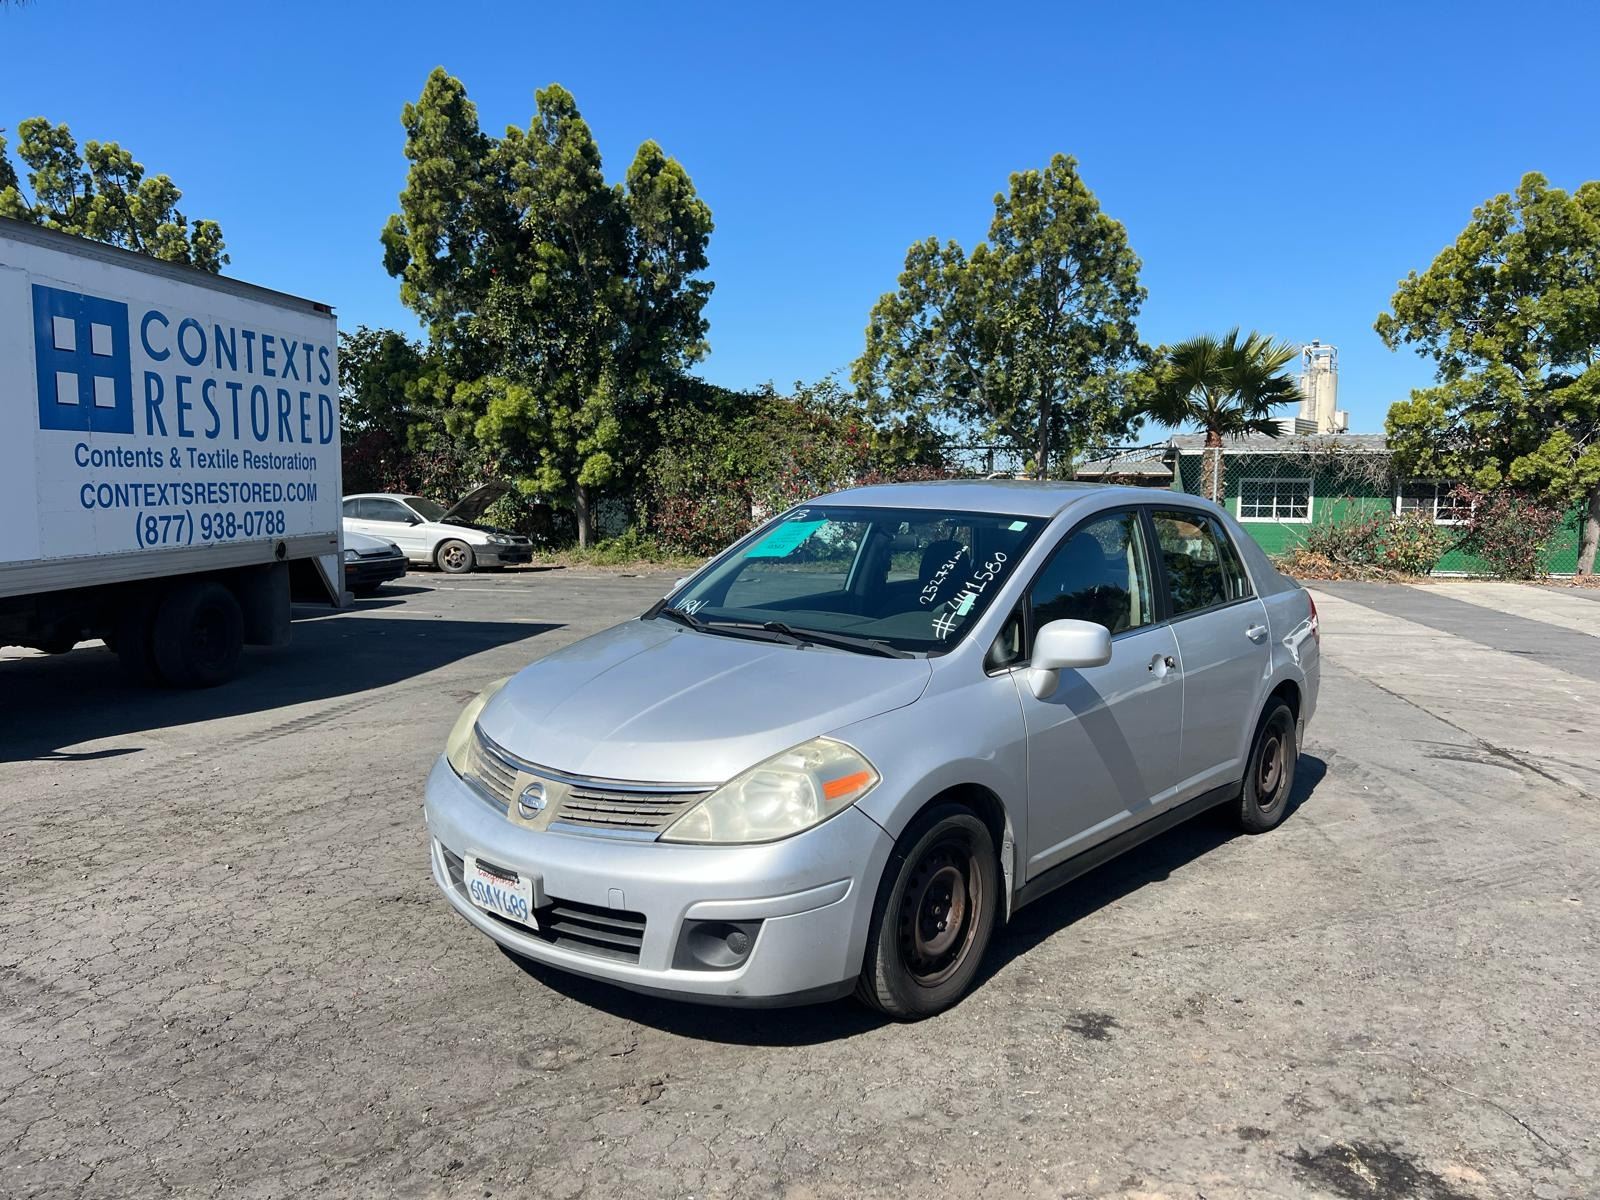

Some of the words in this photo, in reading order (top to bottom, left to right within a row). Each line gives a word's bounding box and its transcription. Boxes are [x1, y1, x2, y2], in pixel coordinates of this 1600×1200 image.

[140, 309, 331, 386] CONTEXTS
[143, 370, 334, 445] RESTORED
[74, 442, 164, 468] Contents
[169, 447, 182, 468] &
[186, 447, 239, 469] Textile
[243, 449, 317, 471] Restoration
[79, 482, 318, 509] CONTEXTSRESTORED.COM
[135, 510, 194, 549] (877)
[200, 510, 286, 541] 938-0788
